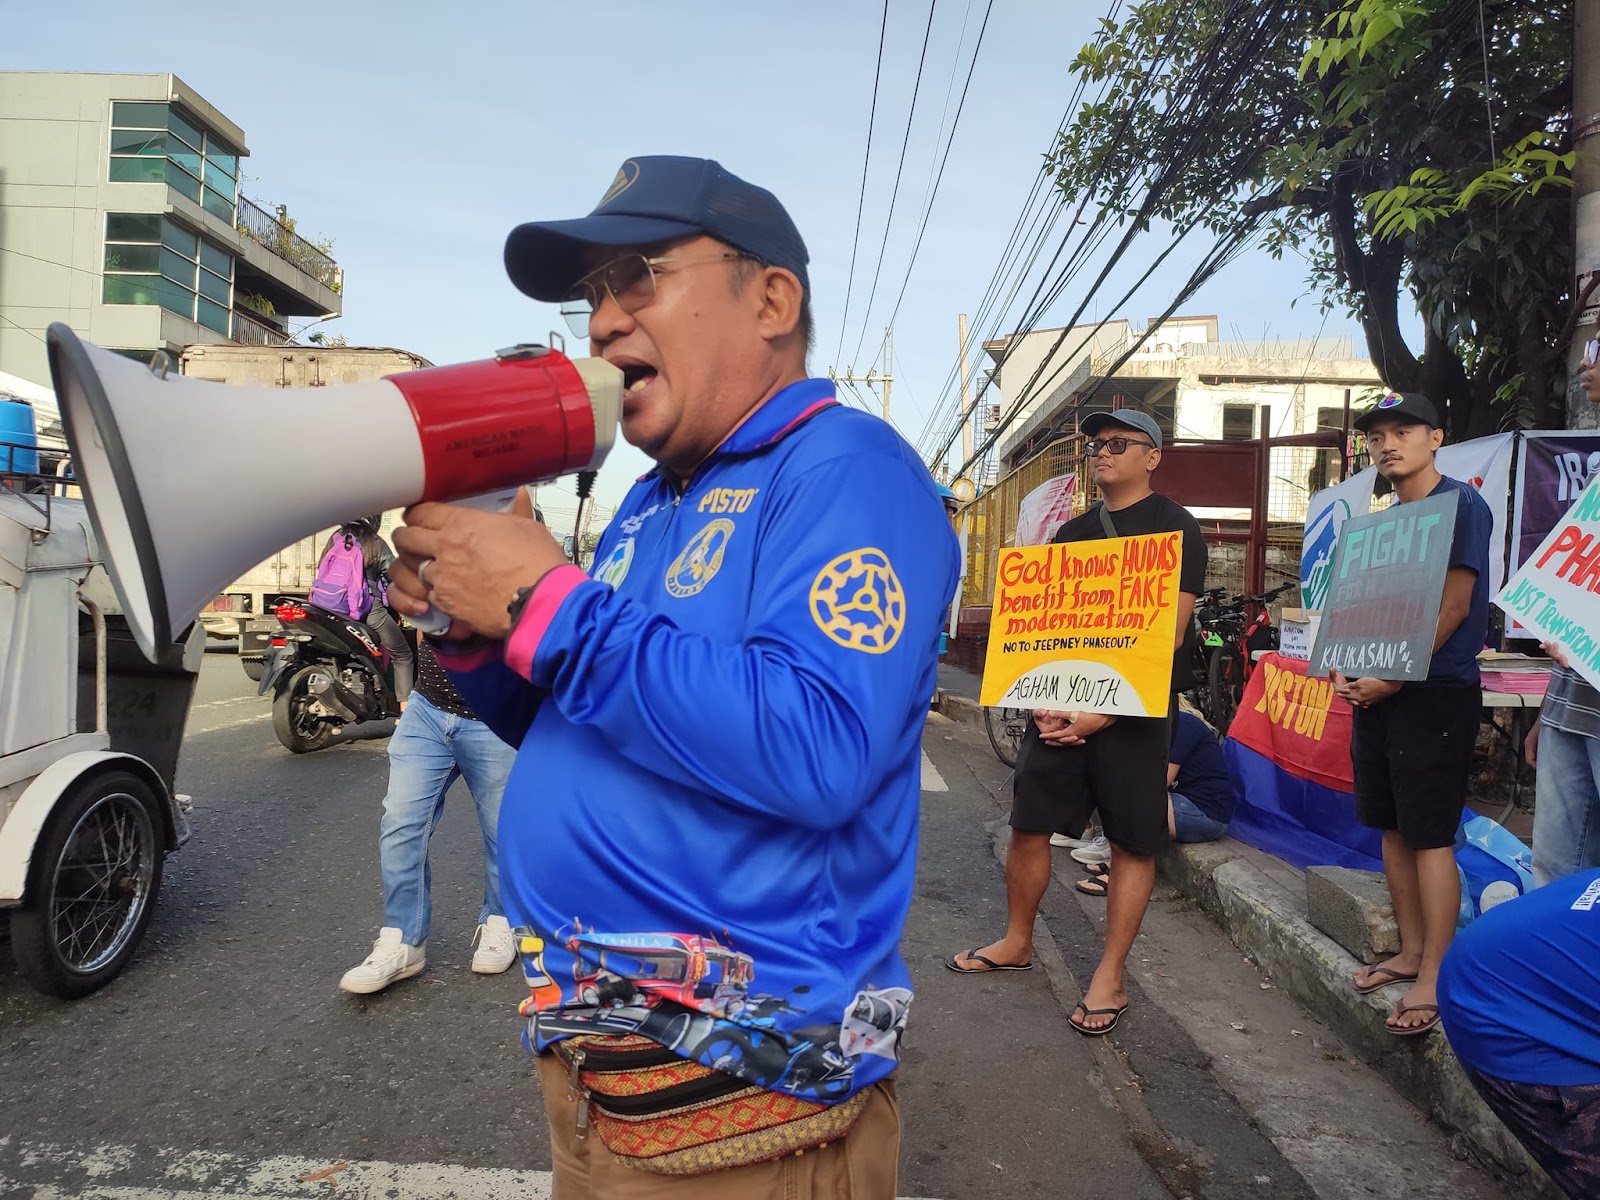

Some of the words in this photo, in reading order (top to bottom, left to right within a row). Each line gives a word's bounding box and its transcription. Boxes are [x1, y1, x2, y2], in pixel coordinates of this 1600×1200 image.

[697, 487, 759, 514] PISTO
[1000, 547, 1053, 586] God
[1059, 546, 1119, 582] knows
[1121, 534, 1178, 576] HUDAS
[1339, 513, 1441, 579] FIGHT
[1535, 525, 1600, 595] PHA
[998, 582, 1067, 616] benefit
[1071, 580, 1115, 610] from
[1119, 572, 1172, 610] FAKE
[1503, 578, 1546, 617] JUST
[1005, 604, 1160, 635] modernization!
[1003, 641, 1017, 653] NO
[1018, 640, 1031, 652] TO
[1033, 638, 1080, 651] JEEPNEY
[1082, 636, 1138, 650] PHASEOUT!
[1320, 642, 1397, 670] KALIKASAN
[1007, 674, 1059, 700] AGHAM
[1065, 674, 1121, 707] YOUTH
